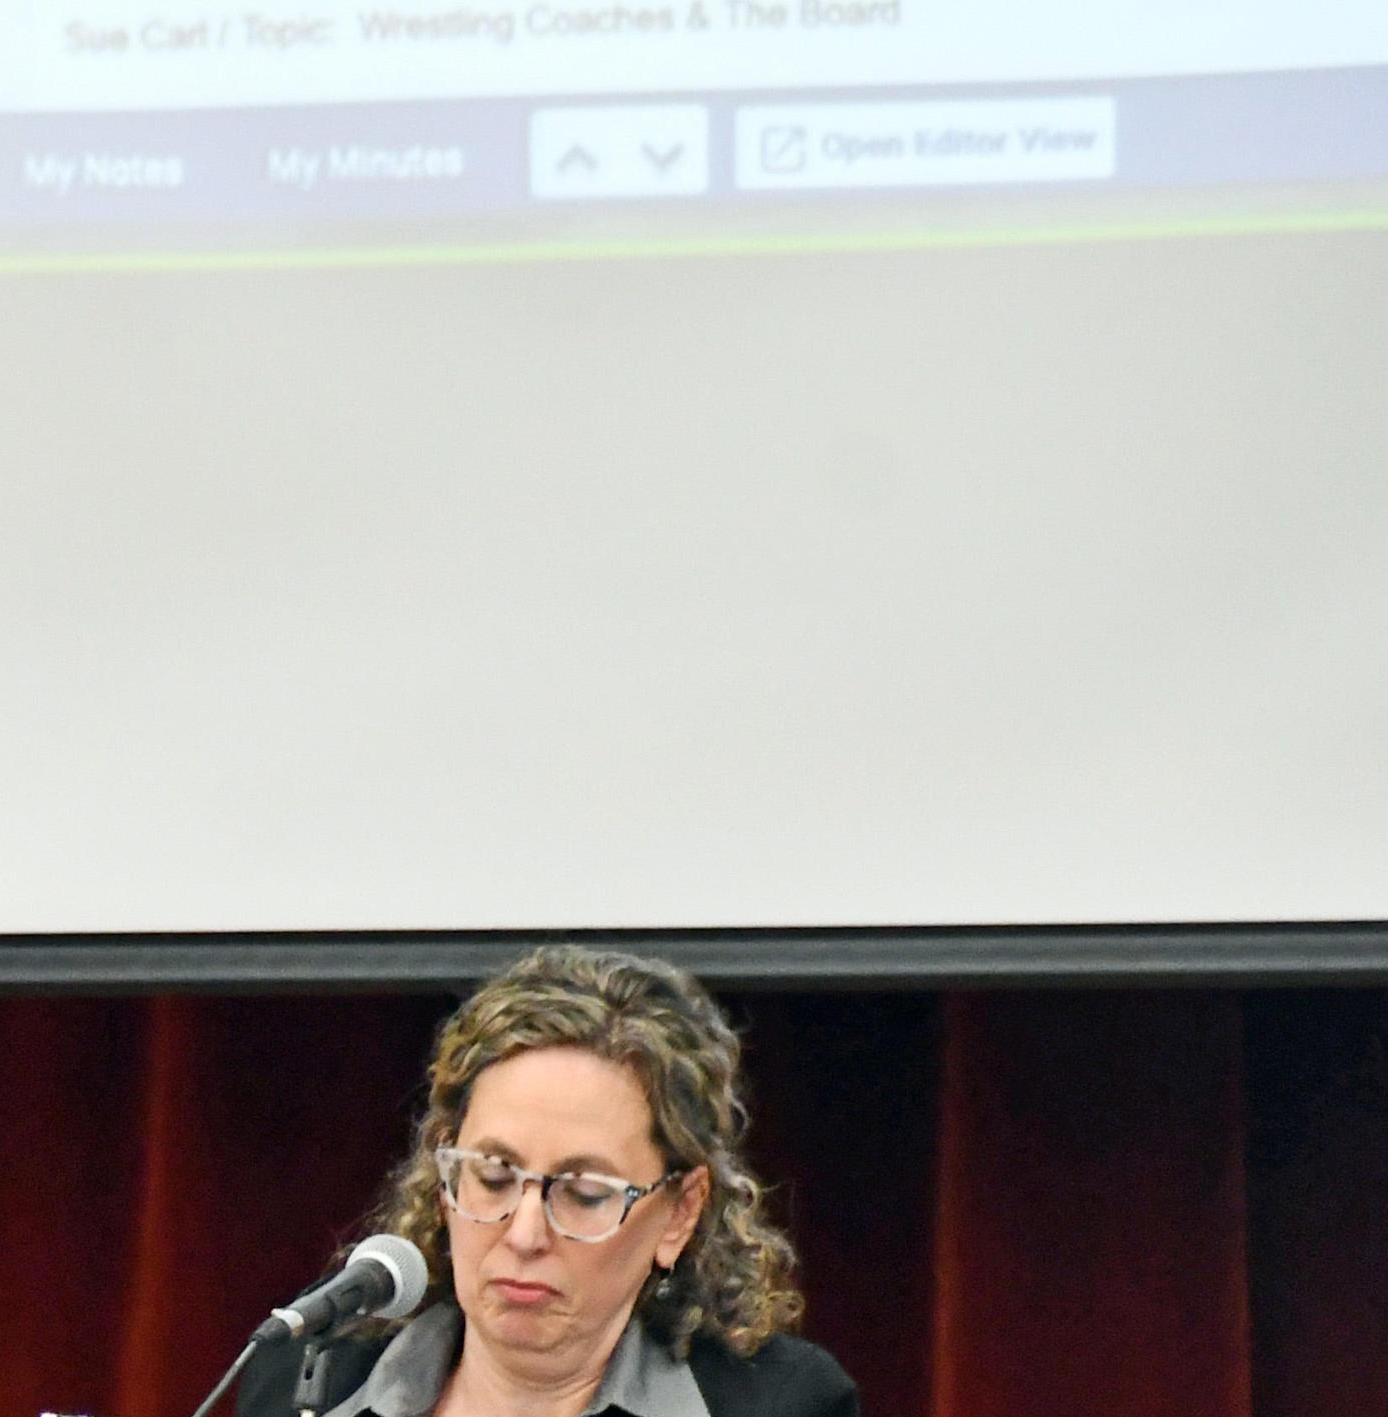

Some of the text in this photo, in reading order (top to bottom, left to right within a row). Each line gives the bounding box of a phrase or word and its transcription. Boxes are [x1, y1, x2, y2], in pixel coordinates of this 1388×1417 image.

[524, 0, 673, 36] Coaches
[687, 0, 710, 31] &
[728, 0, 787, 29] The
[800, 0, 902, 27] Board
[820, 122, 1097, 165] Open Editor View
[25, 152, 183, 192] My Notes
[268, 145, 464, 189] My Minutes
